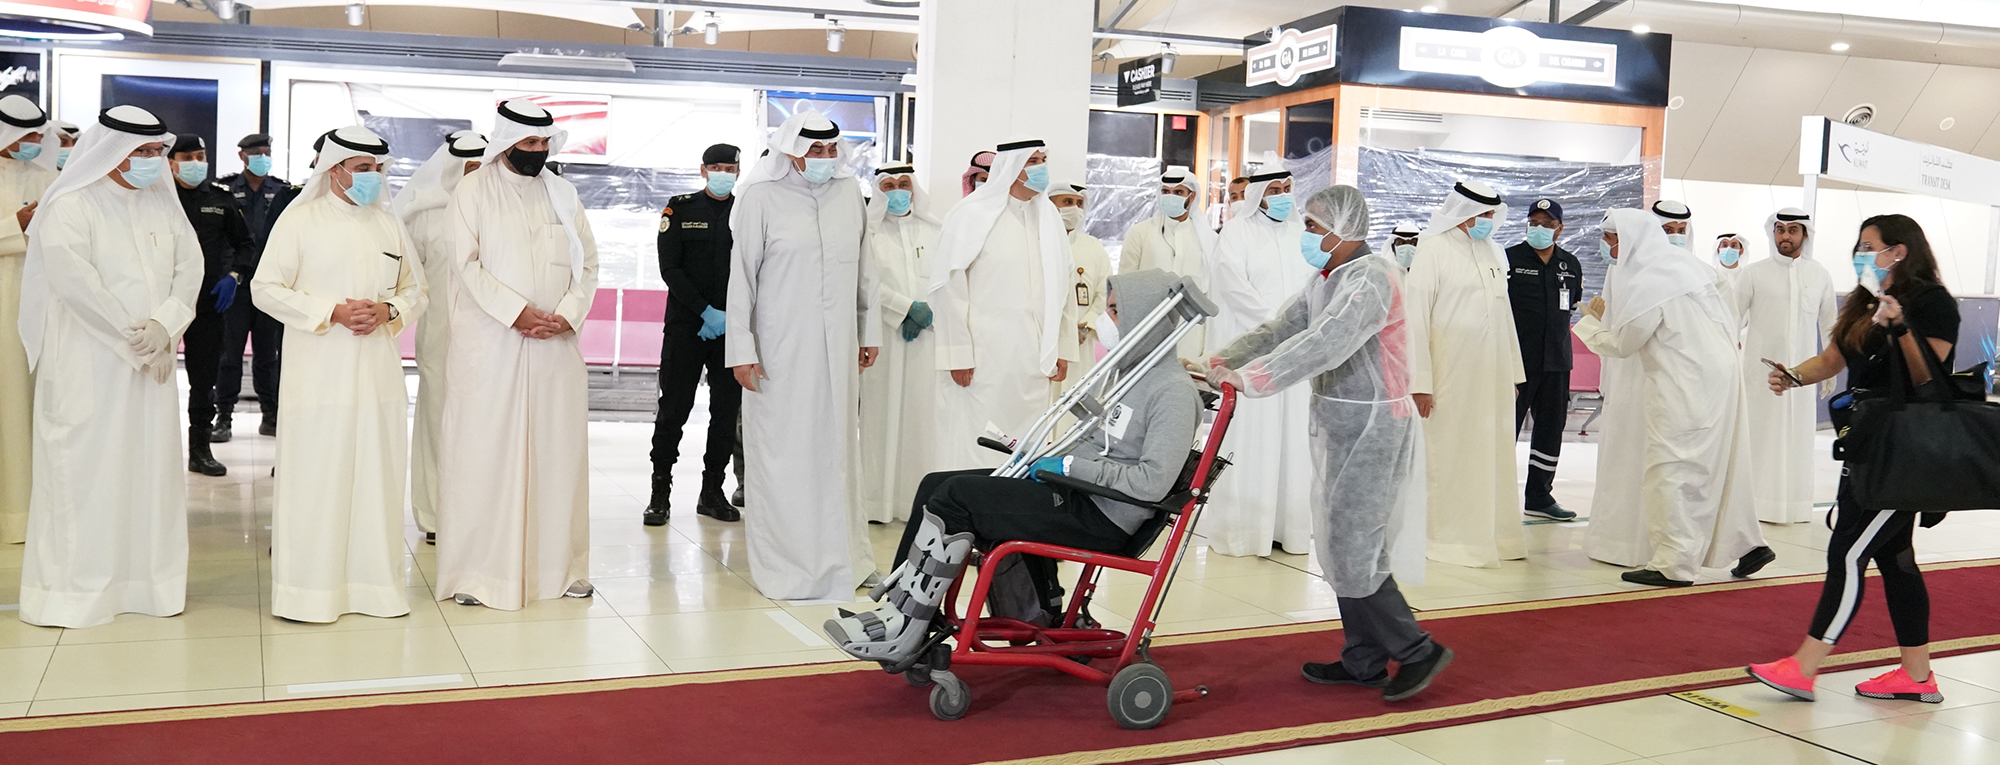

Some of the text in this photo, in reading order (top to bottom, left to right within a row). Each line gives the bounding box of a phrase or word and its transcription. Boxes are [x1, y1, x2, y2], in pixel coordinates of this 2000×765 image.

[1130, 64, 1155, 82] CASHIER
[1853, 158, 1869, 169] KUWAIT
[1921, 173, 1952, 191] TRANSIT DESK
